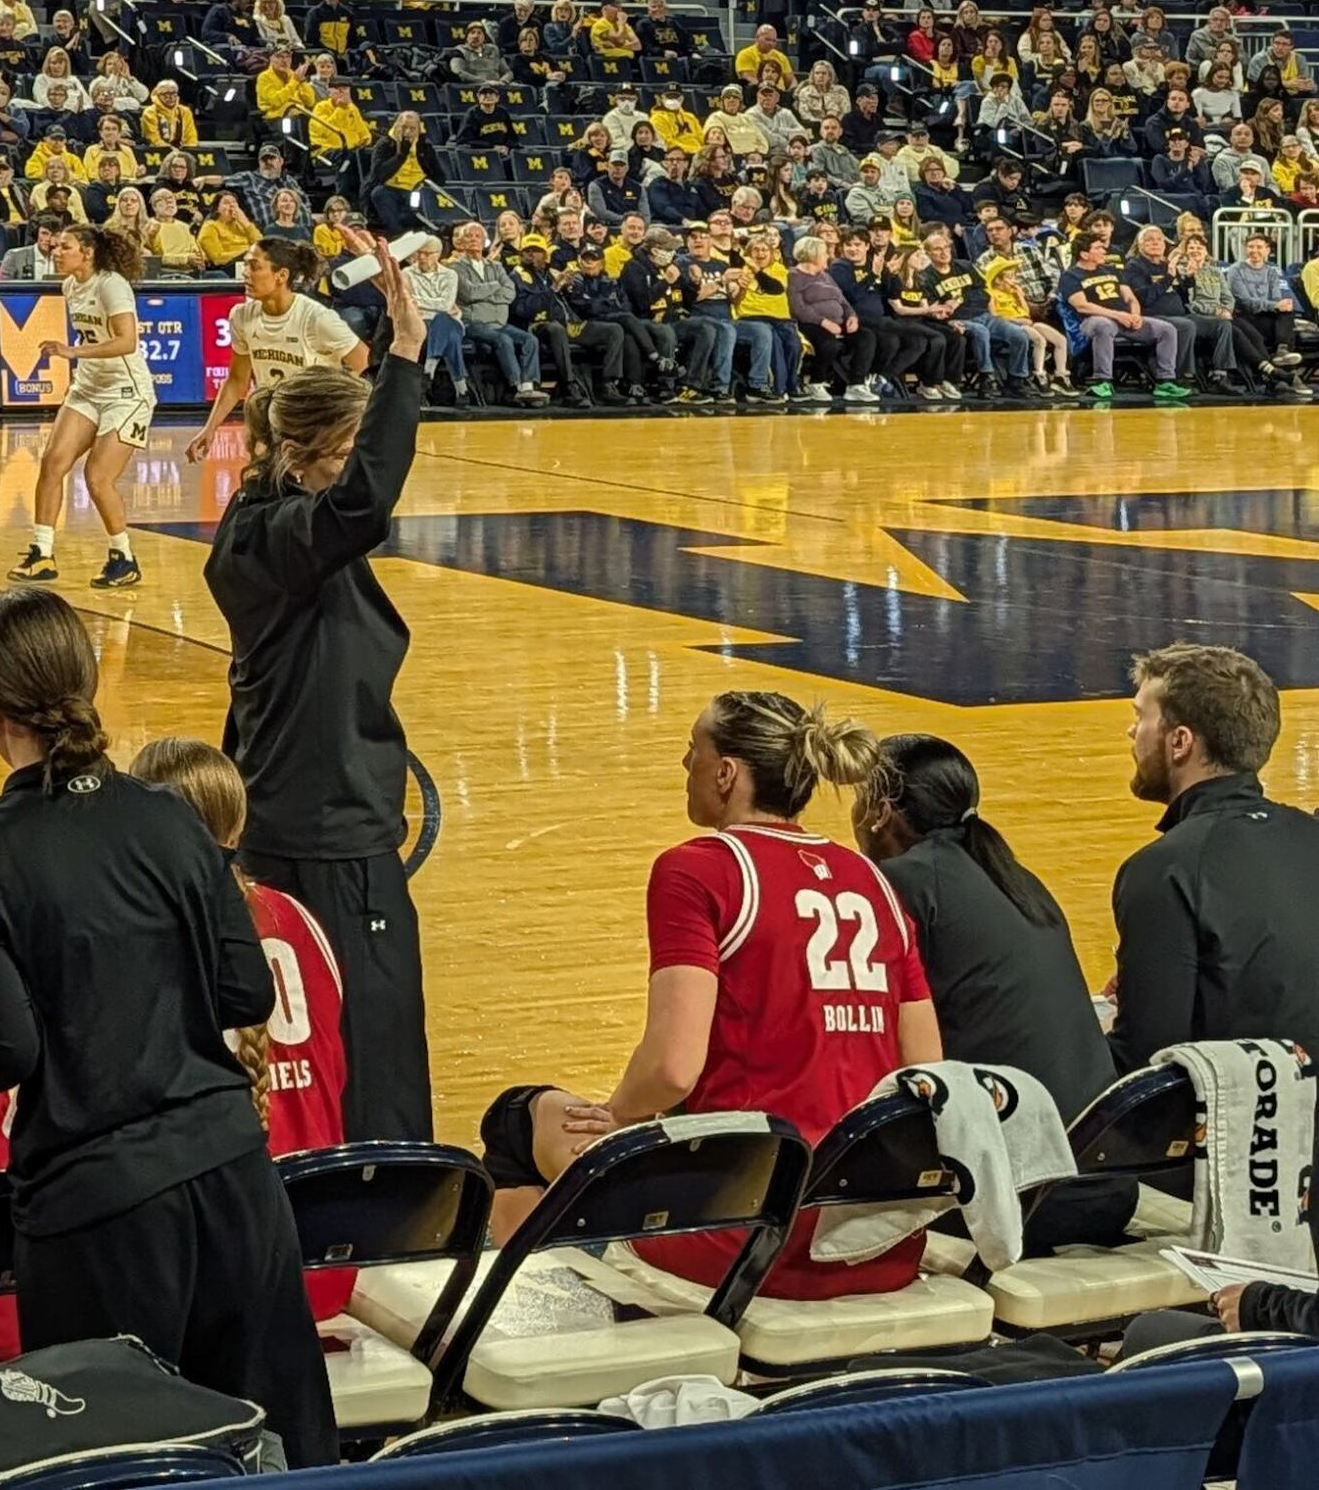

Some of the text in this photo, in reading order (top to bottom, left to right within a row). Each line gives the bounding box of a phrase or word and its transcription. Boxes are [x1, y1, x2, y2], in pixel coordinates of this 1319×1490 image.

[1096, 283, 1117, 300] 12
[18, 382, 53, 394] BONUS
[130, 422, 146, 441] M
[795, 888, 889, 993] 22
